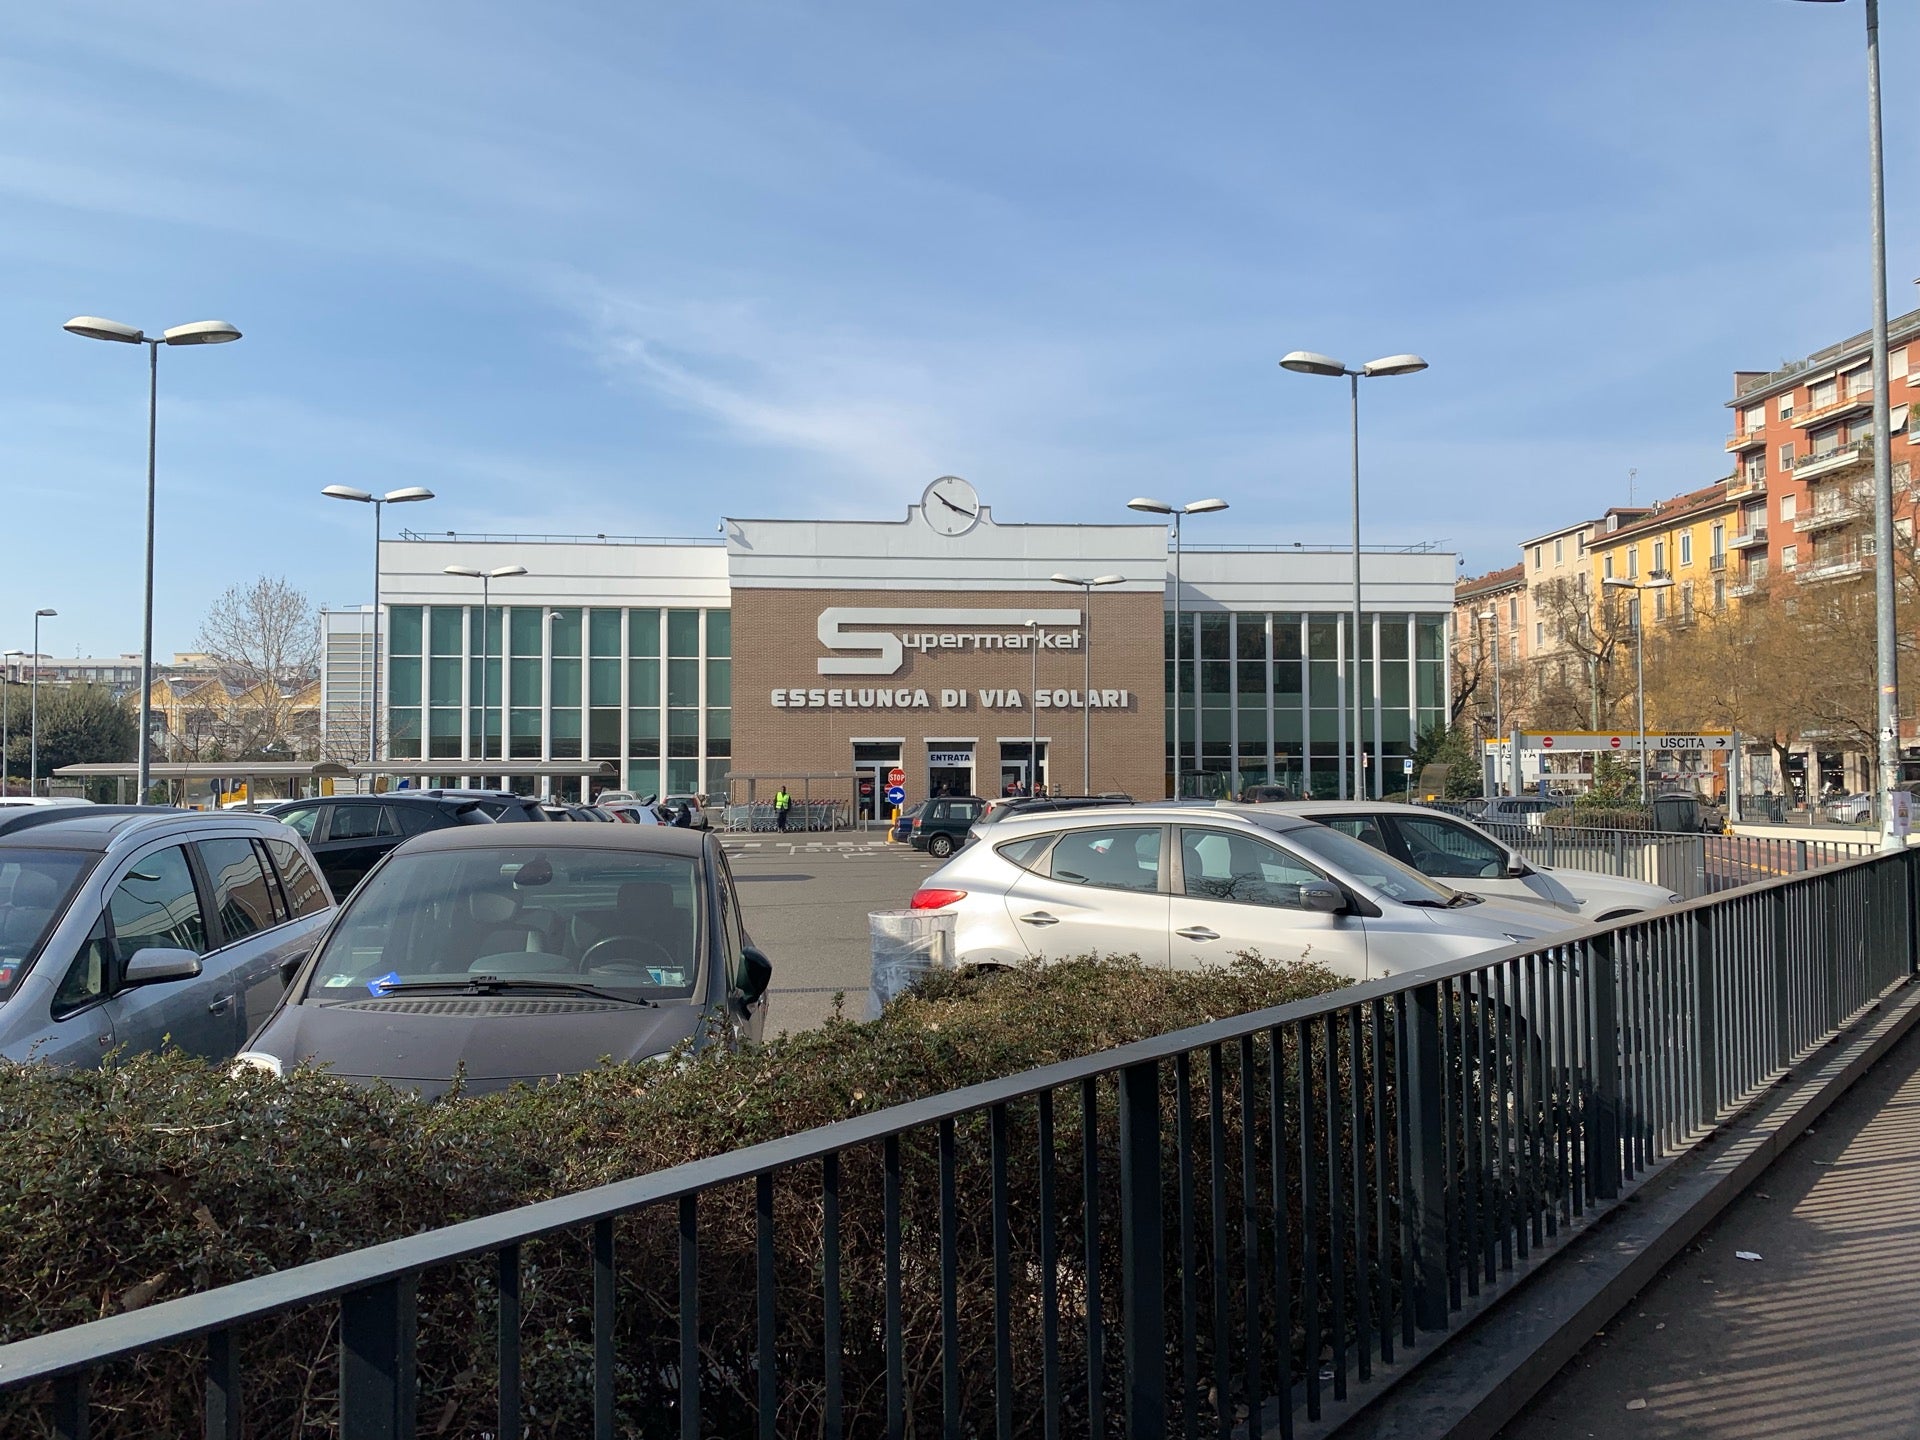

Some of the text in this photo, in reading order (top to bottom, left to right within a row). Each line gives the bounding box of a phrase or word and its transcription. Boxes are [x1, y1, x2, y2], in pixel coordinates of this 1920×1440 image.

[817, 607, 1082, 675] Supermarket
[770, 688, 1129, 708] ESSELUNGA DI VIA SOLARI
[1660, 737, 1705, 749] USCITA
[930, 754, 971, 762] ENTRATA
[889, 774, 905, 782] STOP
